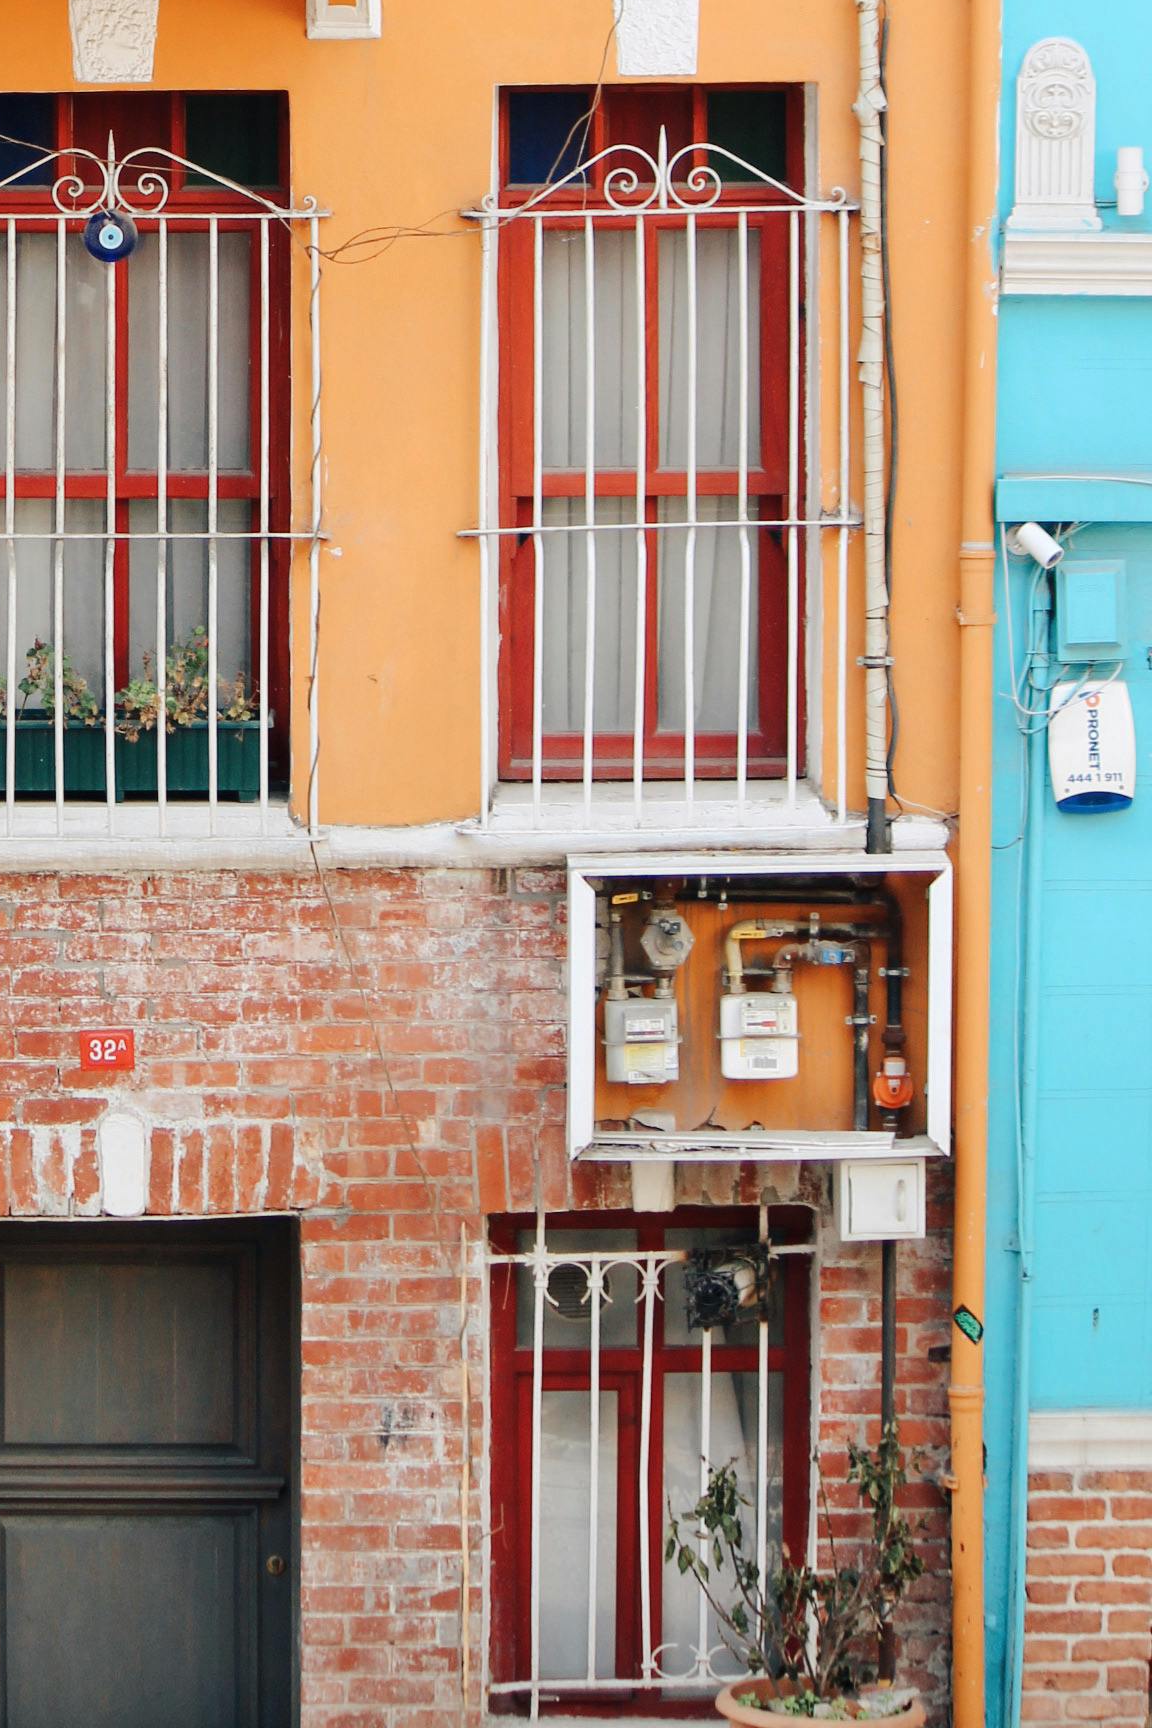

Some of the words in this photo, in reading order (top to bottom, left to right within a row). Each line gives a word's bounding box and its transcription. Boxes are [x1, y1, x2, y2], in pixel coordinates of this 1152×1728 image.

[1088, 710, 1100, 770] PRONET
[1067, 773, 1092, 783] 444
[1104, 772, 1123, 782] 911
